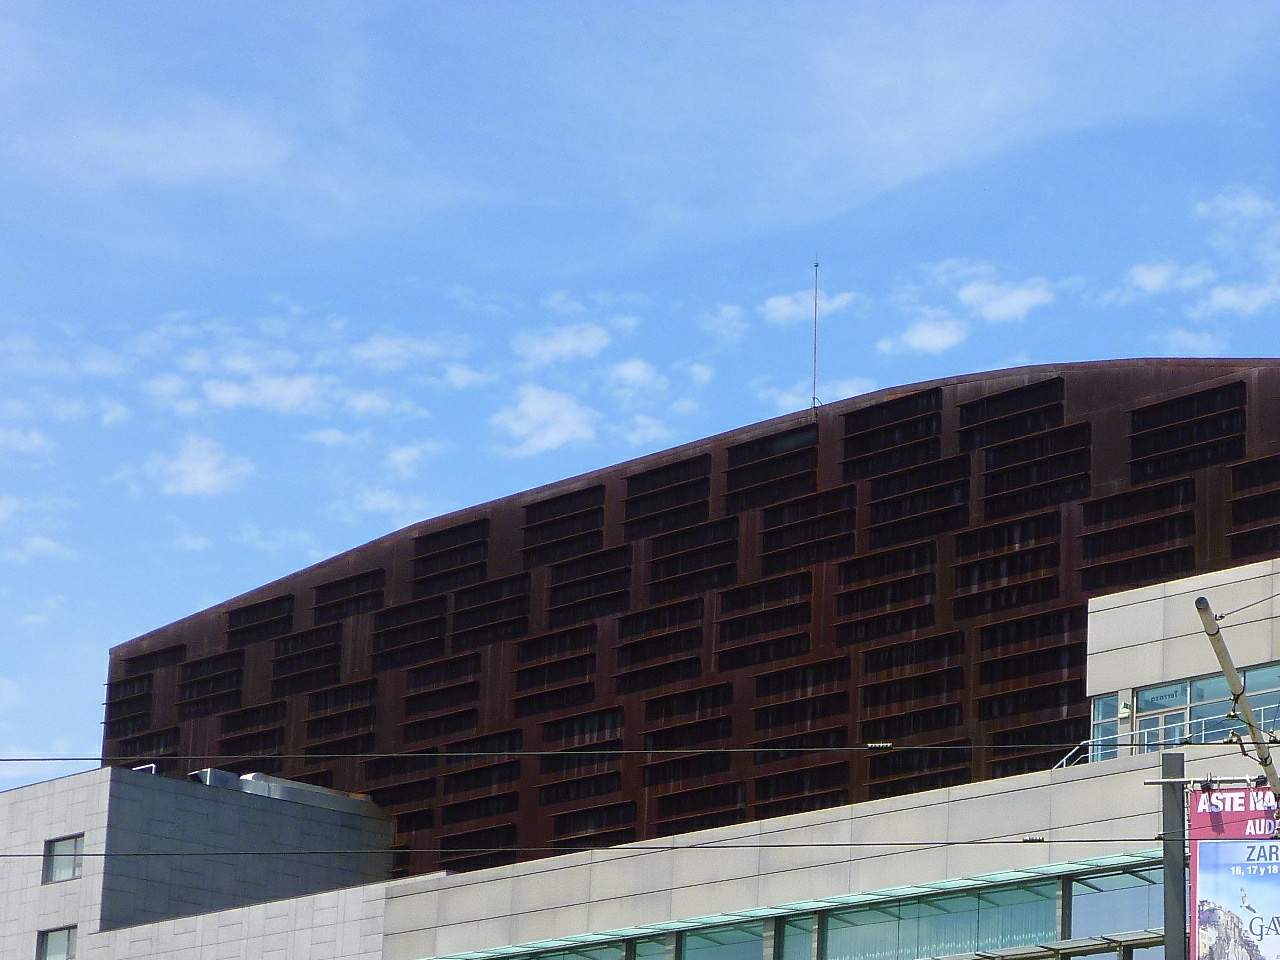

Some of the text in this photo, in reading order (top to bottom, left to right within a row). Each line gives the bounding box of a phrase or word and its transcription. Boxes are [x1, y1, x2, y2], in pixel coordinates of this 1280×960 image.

[1197, 791, 1246, 813] ASTE
[1247, 866, 1258, 875] 17
[1259, 867, 1266, 876] y
[1267, 865, 1279, 874] 18
